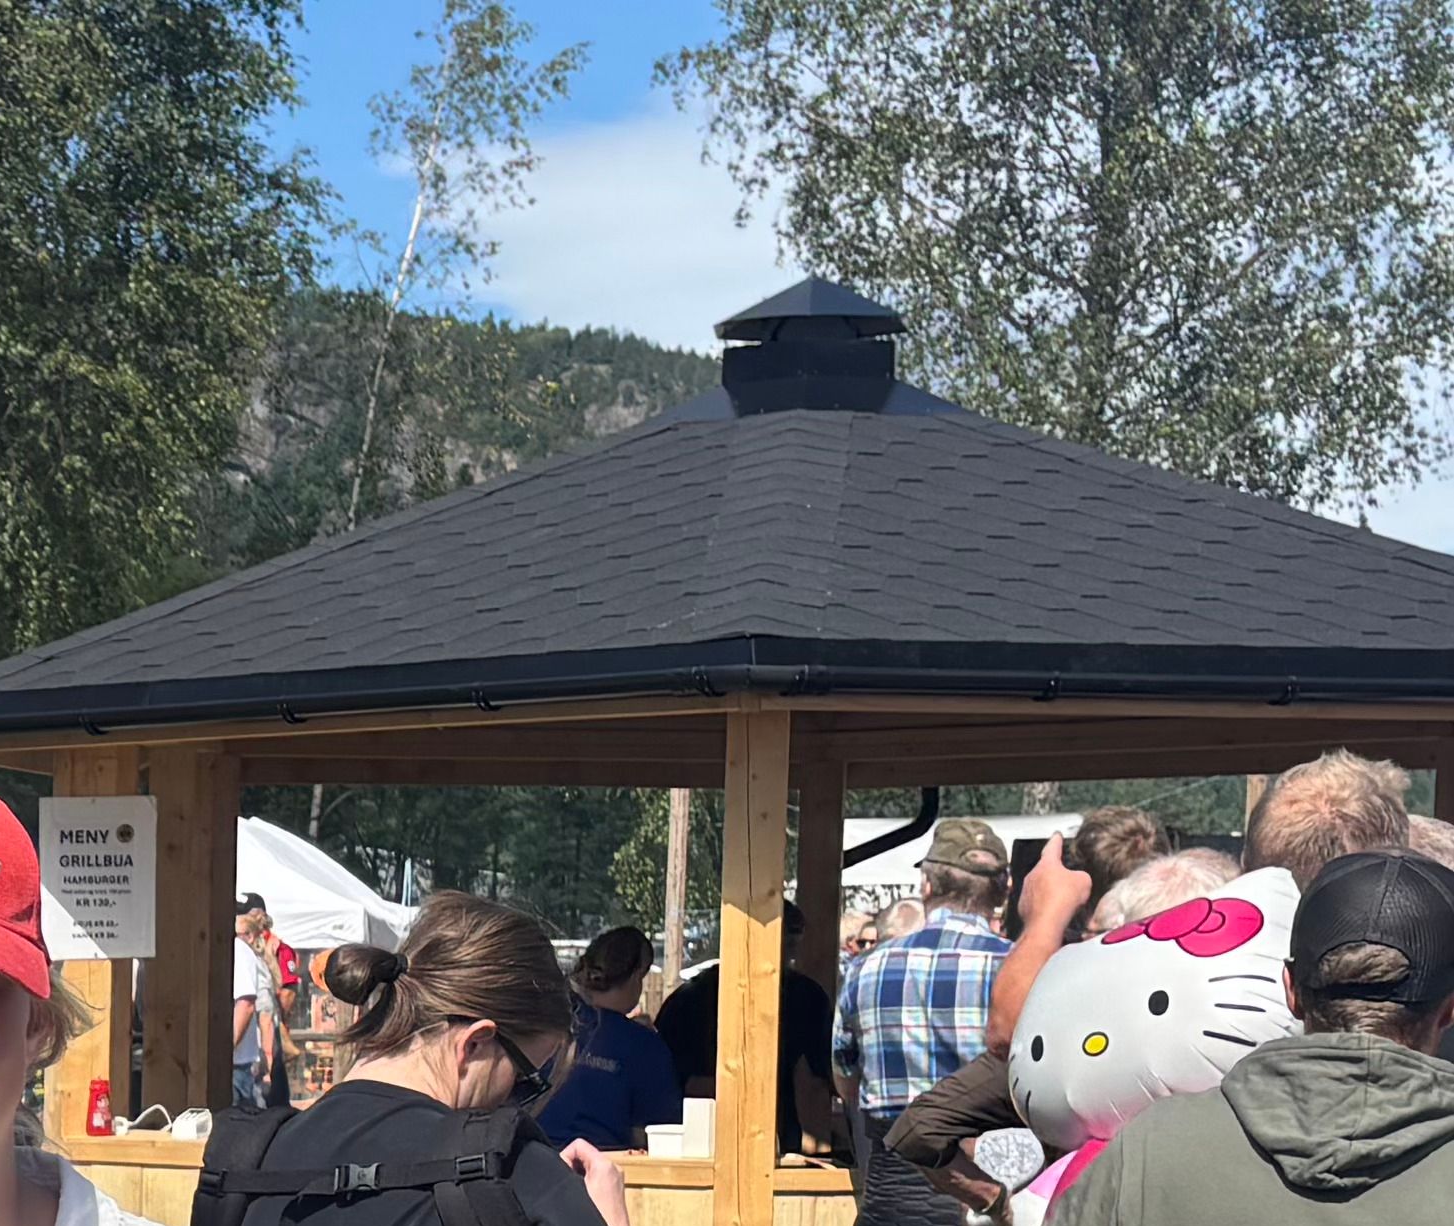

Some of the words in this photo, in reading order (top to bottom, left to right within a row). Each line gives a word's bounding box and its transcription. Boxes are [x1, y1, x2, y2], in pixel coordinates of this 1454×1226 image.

[59, 829, 109, 845] MENY
[59, 854, 134, 868] GRILLBUA
[63, 875, 130, 885] HAMBURGER
